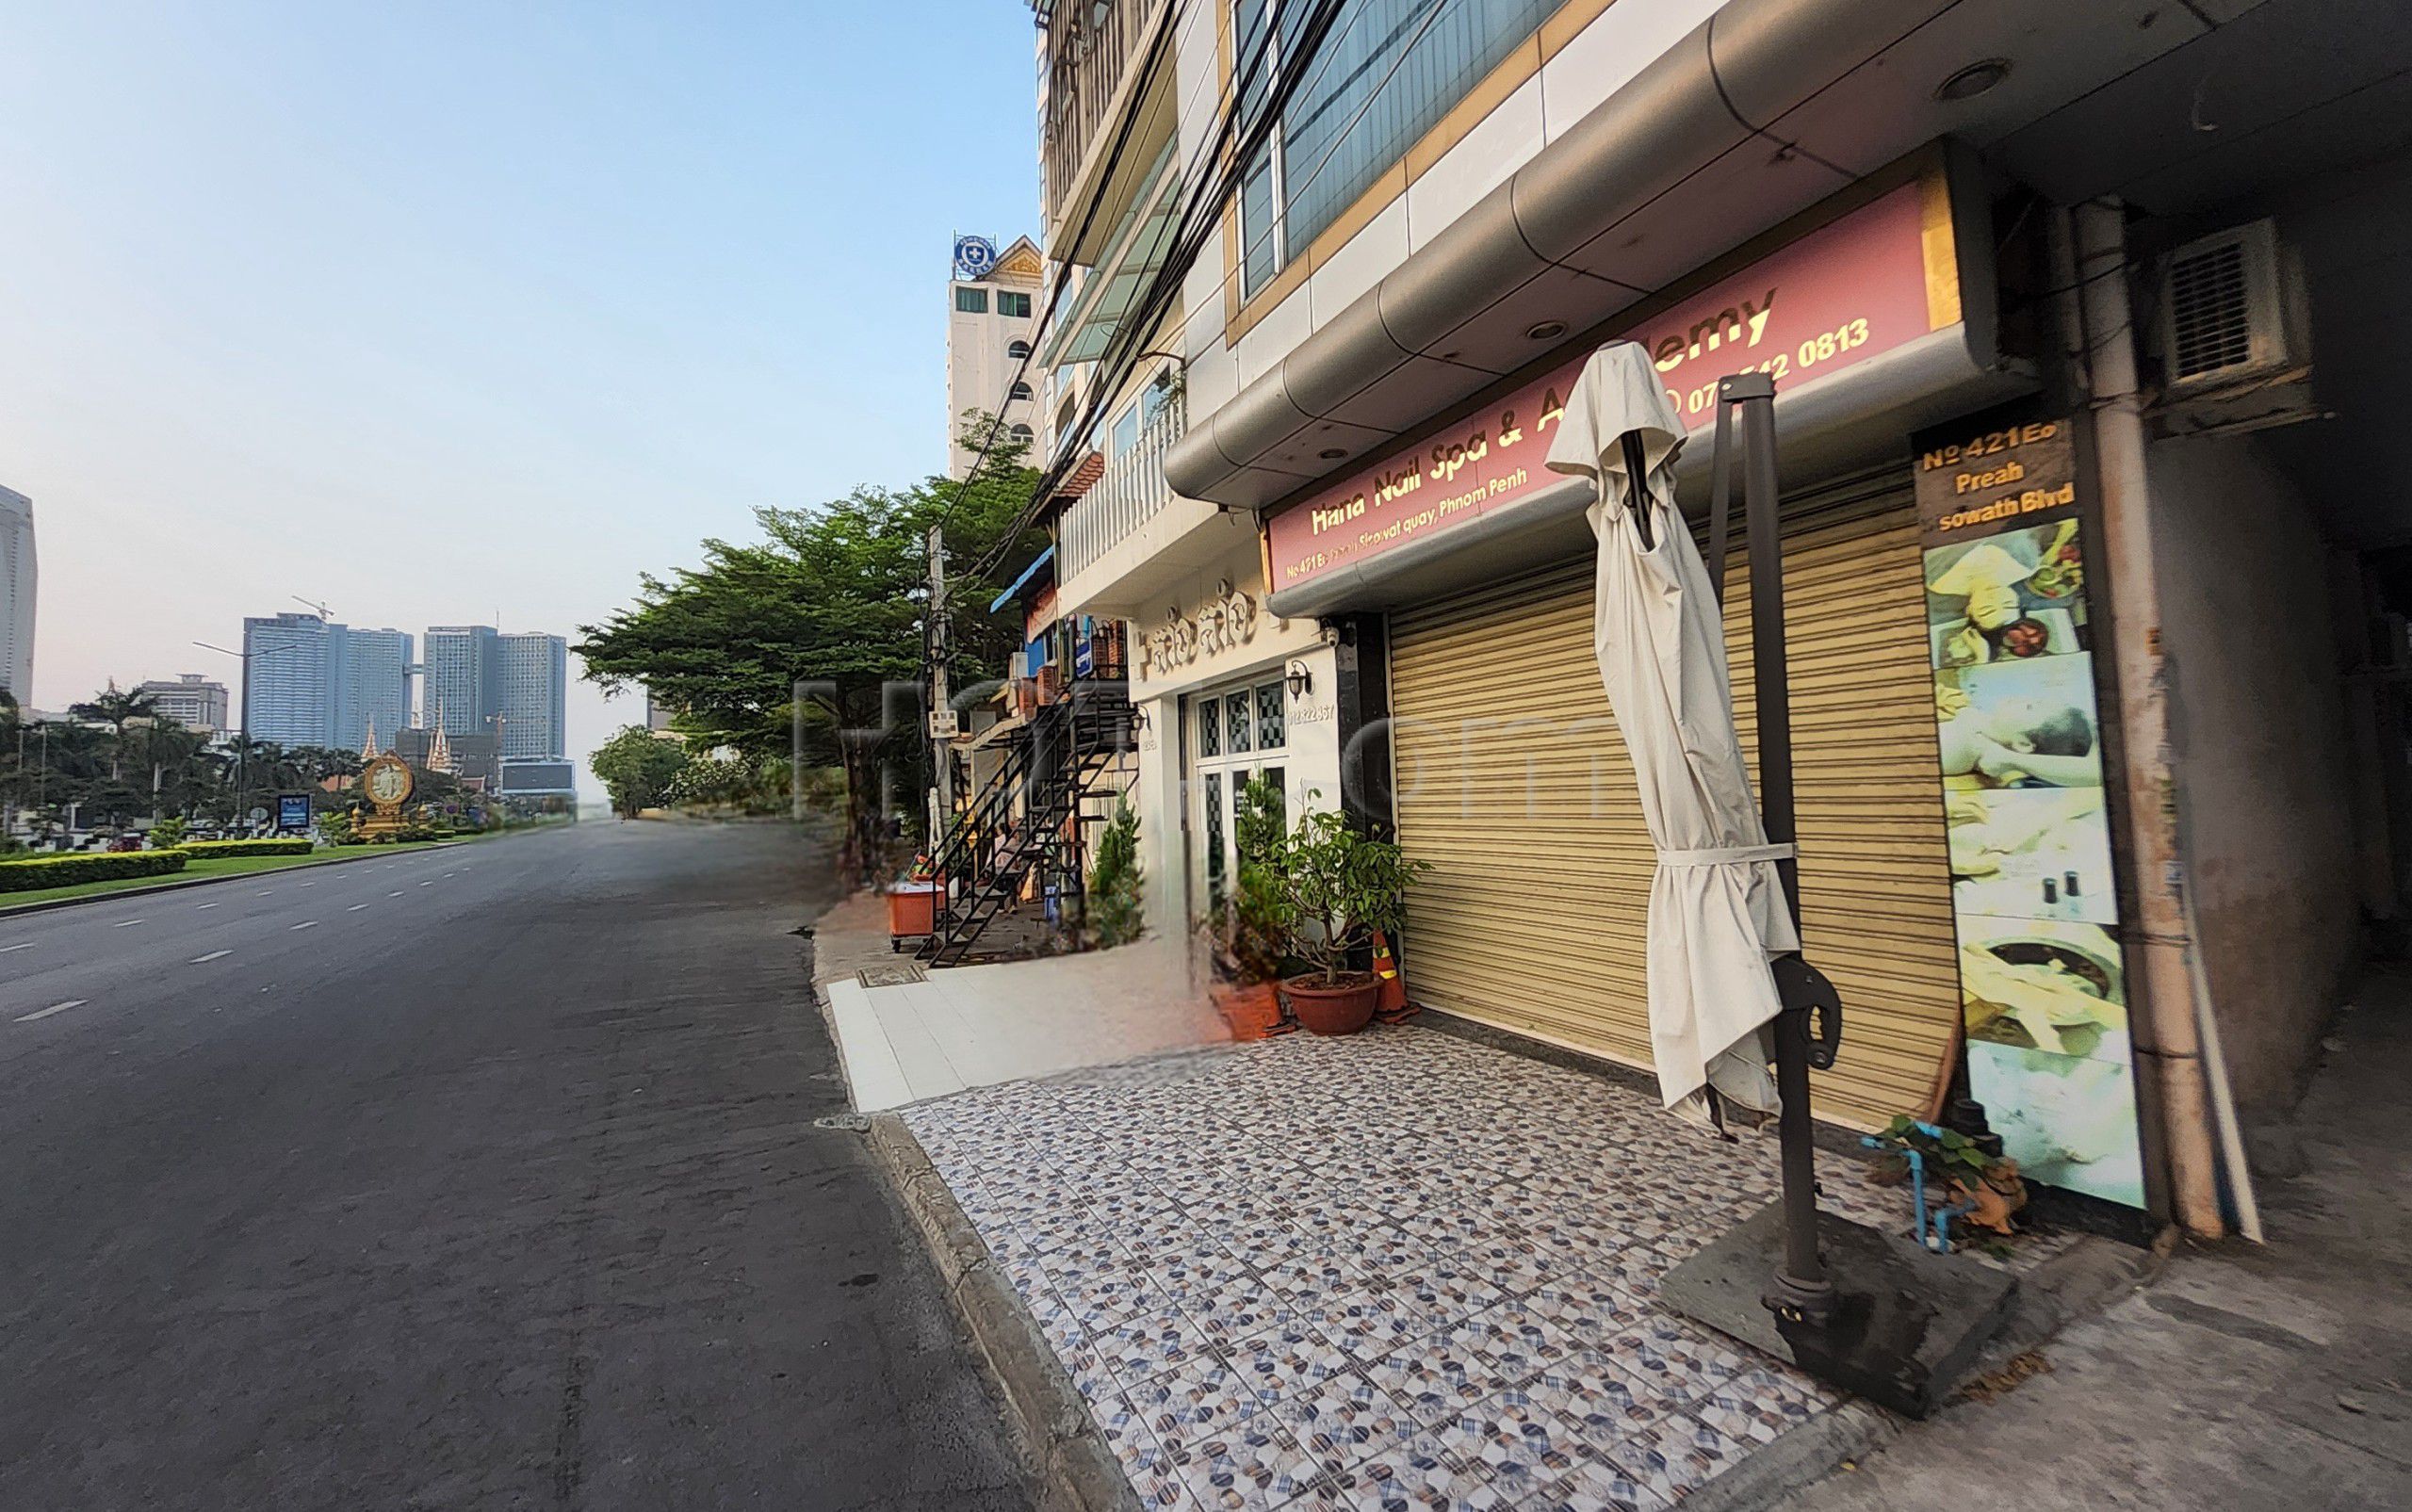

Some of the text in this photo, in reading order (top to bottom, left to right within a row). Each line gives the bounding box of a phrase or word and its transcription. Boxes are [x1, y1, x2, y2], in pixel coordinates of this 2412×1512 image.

[1798, 317, 1869, 367] 0813
[1311, 492, 1365, 537] Hana
[1374, 455, 1421, 507] Nail
[1430, 430, 1488, 481] Spa
[1498, 410, 1523, 447] &
[1537, 286, 1778, 432] Aemy
[1403, 508, 1438, 533] quay,
[1439, 487, 1487, 517] Phnom
[1489, 467, 1528, 497] Penh
[1956, 461, 2025, 495] Preah
